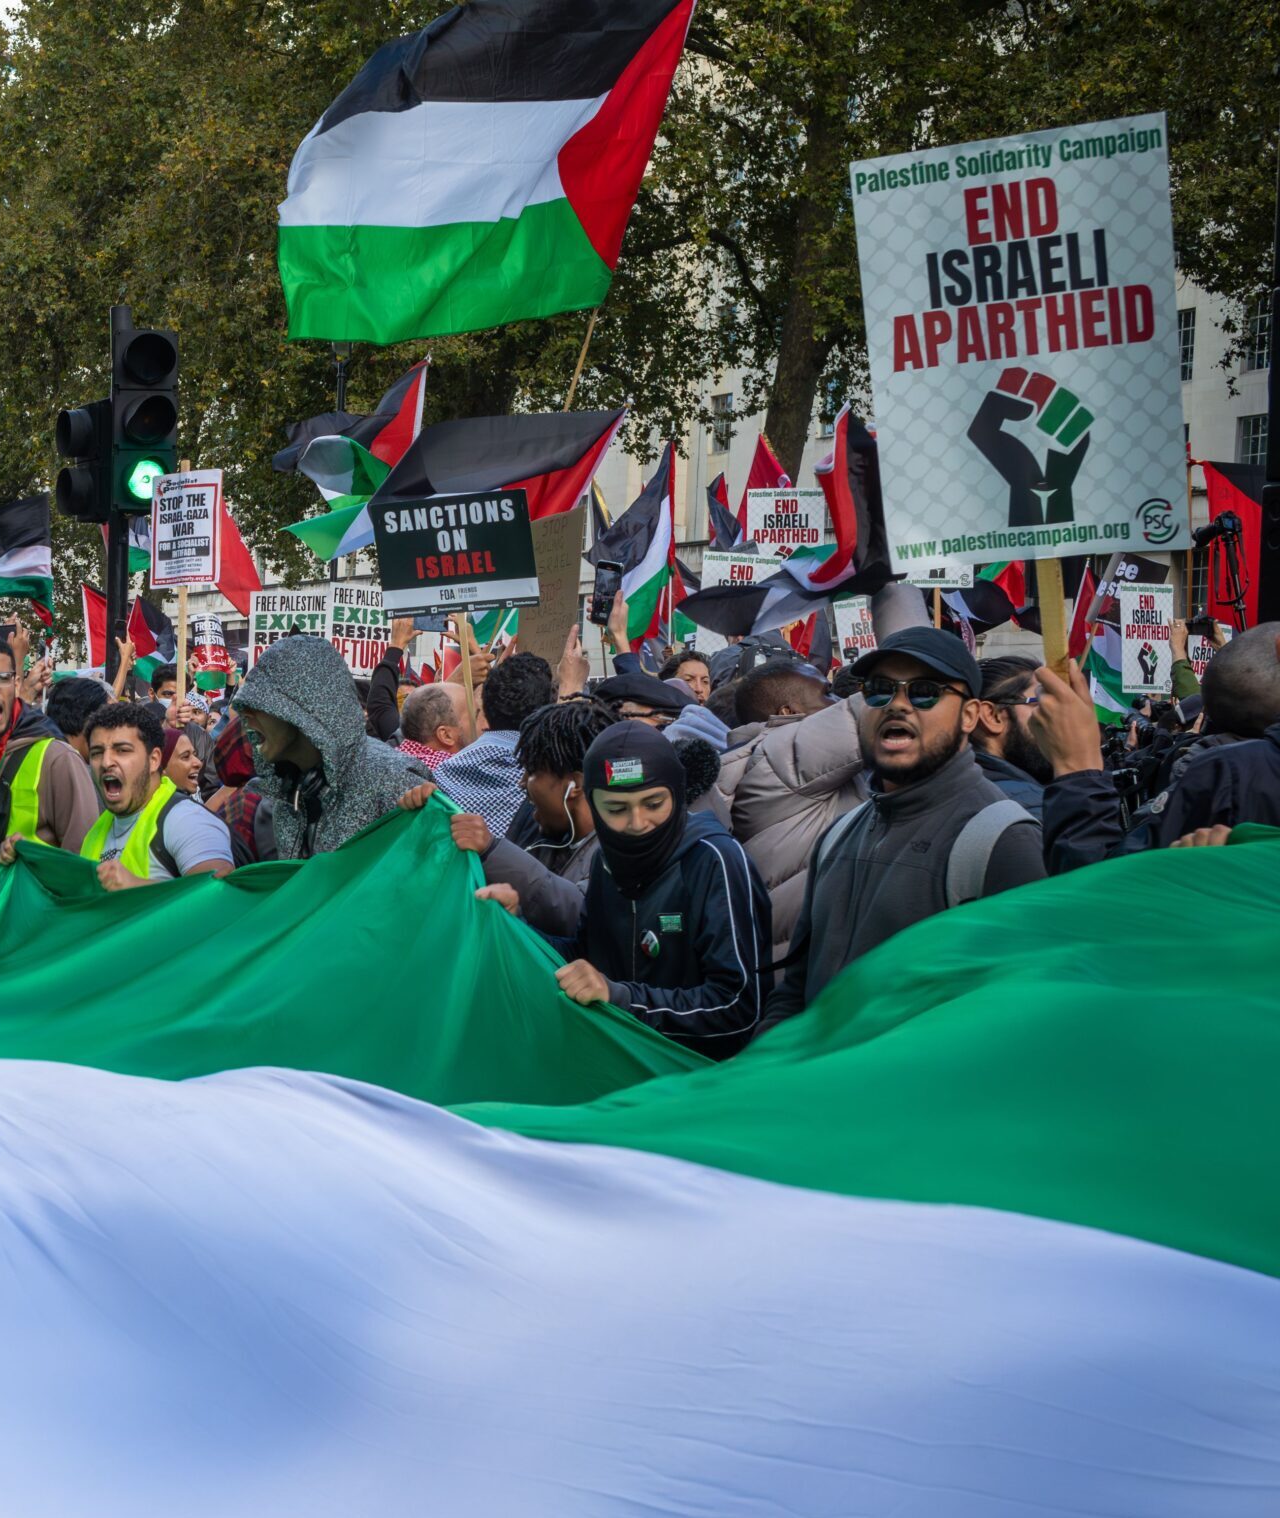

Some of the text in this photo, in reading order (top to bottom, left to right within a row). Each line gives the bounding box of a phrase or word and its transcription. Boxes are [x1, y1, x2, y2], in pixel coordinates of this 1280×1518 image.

[855, 127, 1162, 195] Palestine Solidarity Campaign
[964, 177, 1059, 246] END
[926, 228, 1109, 309] ISRAELI
[893, 284, 1155, 371] APARTHEID
[160, 493, 206, 512] STOP THE
[774, 490, 798, 498] Solidarity
[775, 499, 798, 514] END
[160, 508, 209, 525] ISRAEL-GAZA
[384, 499, 515, 534] SANCTIONS
[763, 514, 809, 529] ISRAELI
[1144, 514, 1171, 529] PSC
[172, 521, 194, 538] WAR
[753, 528, 819, 544] APARTHEID
[159, 542, 171, 552] FOR
[177, 538, 210, 548] SOCIALIST
[437, 529, 468, 553] ON
[896, 521, 1130, 561] www.palestinecampaign.org
[416, 551, 496, 579] ISRAEL
[704, 554, 729, 562] Palestine
[730, 555, 754, 563] Solidarity
[730, 564, 754, 581] END
[1115, 560, 1139, 581] ee
[255, 595, 327, 612] FREE PALESTINE
[334, 587, 384, 607] FREE PALEST
[439, 589, 456, 601] FOA
[1139, 595, 1154, 610] END
[255, 613, 327, 631] EXIST!
[333, 606, 389, 626] EXIST
[1132, 609, 1162, 625] ISRAELI
[194, 620, 222, 633] FREEDO
[1125, 623, 1170, 641] APARTHEID
[194, 635, 226, 647] PALESTIN
